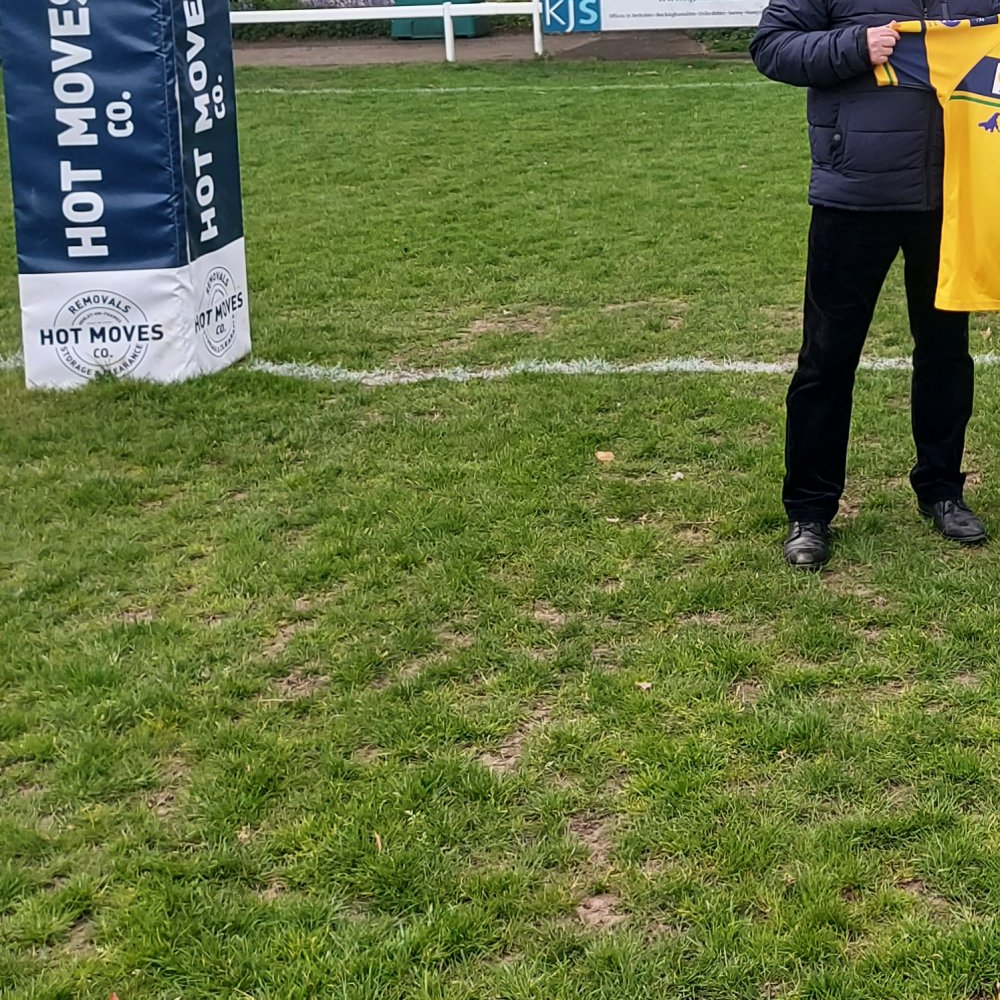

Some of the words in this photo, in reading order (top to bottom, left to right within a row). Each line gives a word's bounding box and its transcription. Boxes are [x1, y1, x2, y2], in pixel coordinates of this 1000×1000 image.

[106, 91, 134, 137] CO.
[211, 74, 226, 119] CO.
[60, 160, 109, 258] HOT
[194, 148, 218, 242] HOT
[68, 295, 131, 314] REMOVALS
[194, 309, 213, 333] HOT
[215, 292, 243, 322] MOVES
[40, 328, 82, 346] HOT
[90, 324, 164, 343] MOVES
[215, 323, 226, 335] CO.
[60, 346, 92, 376] STORAGE
[93, 347, 113, 359] CO.
